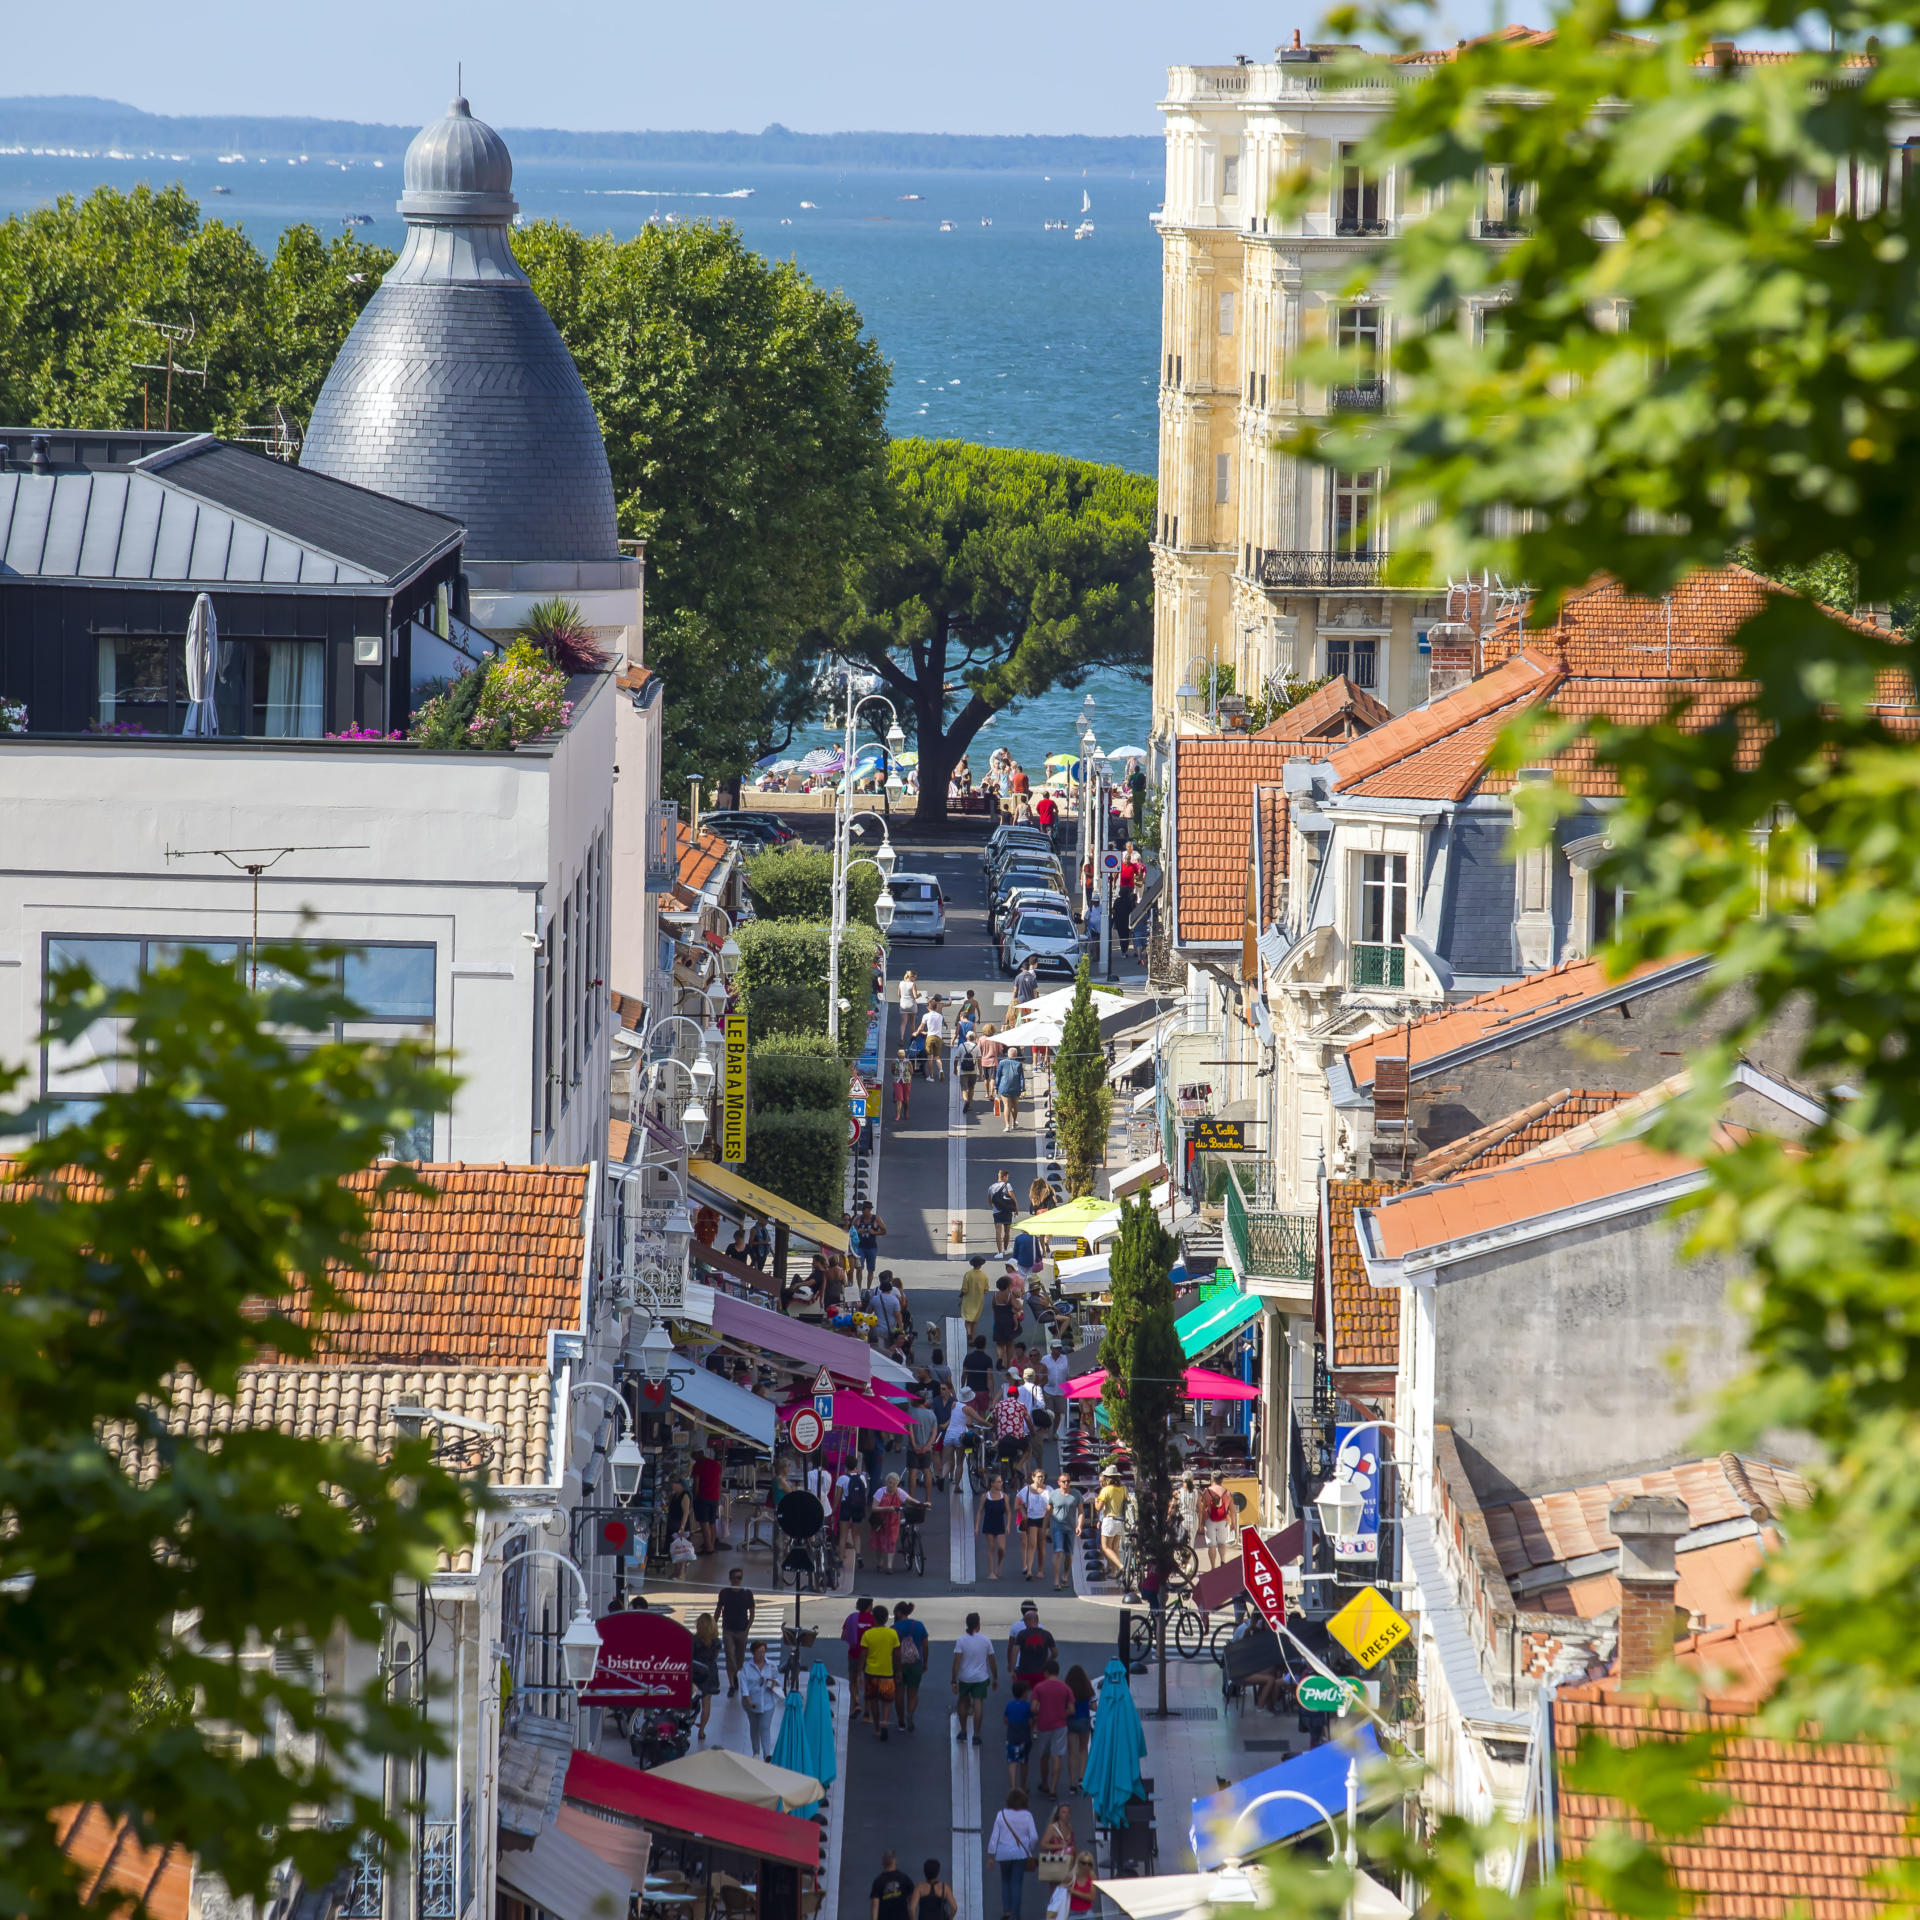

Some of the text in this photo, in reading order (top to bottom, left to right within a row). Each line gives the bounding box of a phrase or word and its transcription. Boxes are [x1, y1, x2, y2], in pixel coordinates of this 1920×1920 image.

[725, 1019, 745, 1159] LE BAR A MOULES
[1200, 1123, 1213, 1135] La
[1195, 1137, 1243, 1149] du Boucher
[1250, 1550, 1277, 1609] TABAC
[1360, 1622, 1403, 1662] PRESSE
[1302, 1687, 1337, 1702] PMU
